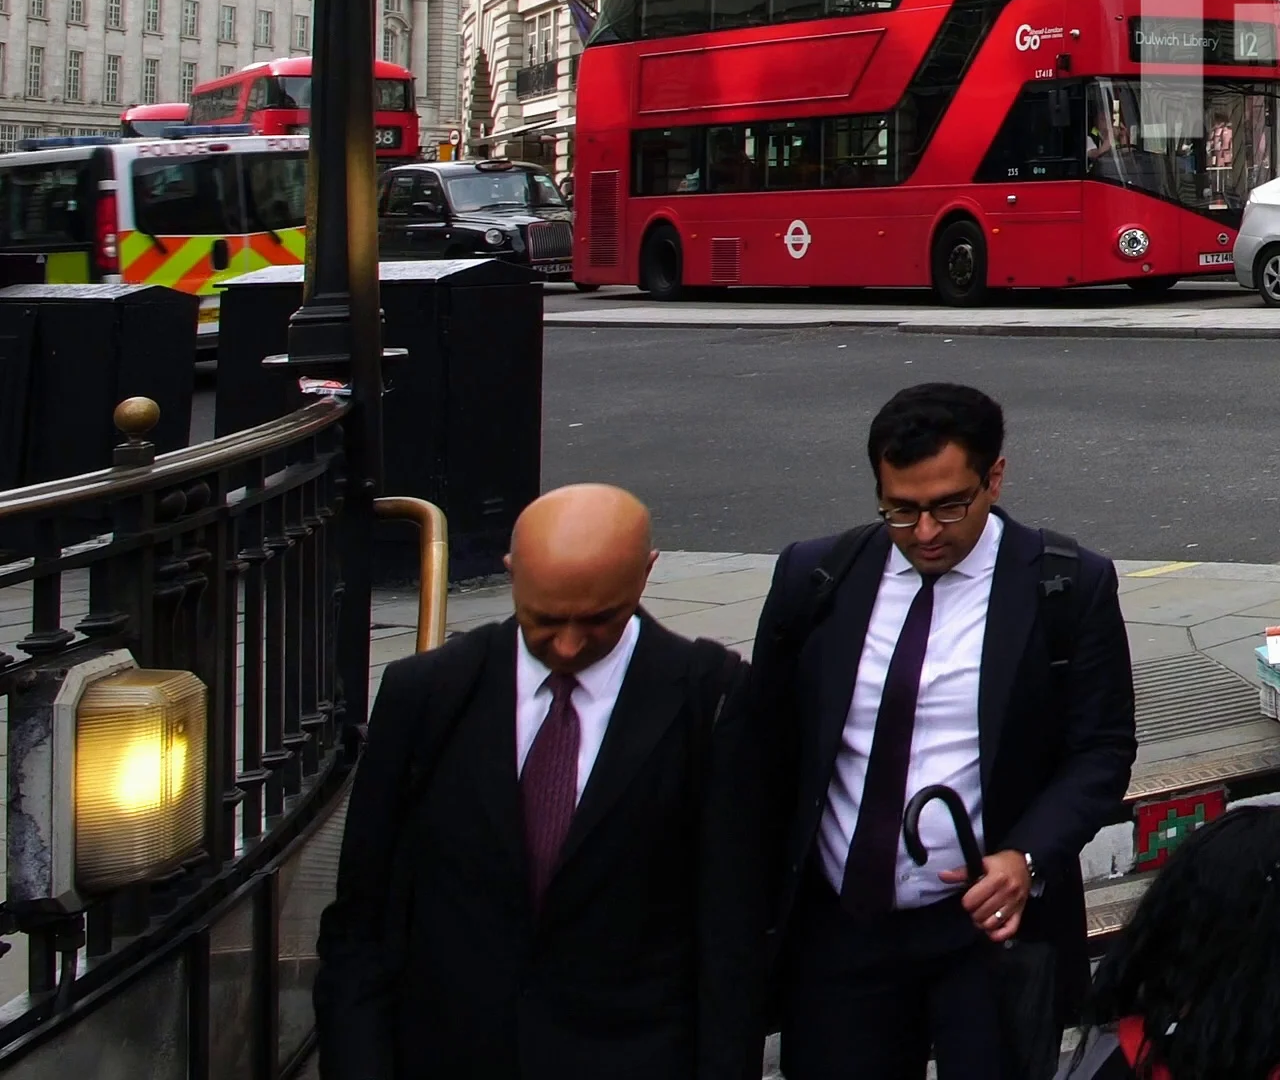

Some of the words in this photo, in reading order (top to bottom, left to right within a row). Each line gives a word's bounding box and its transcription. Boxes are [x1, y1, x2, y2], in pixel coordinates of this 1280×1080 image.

[1015, 24, 1040, 51] Go
[1135, 31, 1180, 46] Dulwich
[1183, 32, 1220, 51] Library
[1239, 31, 1258, 57] 12
[137, 142, 208, 158] POLICE
